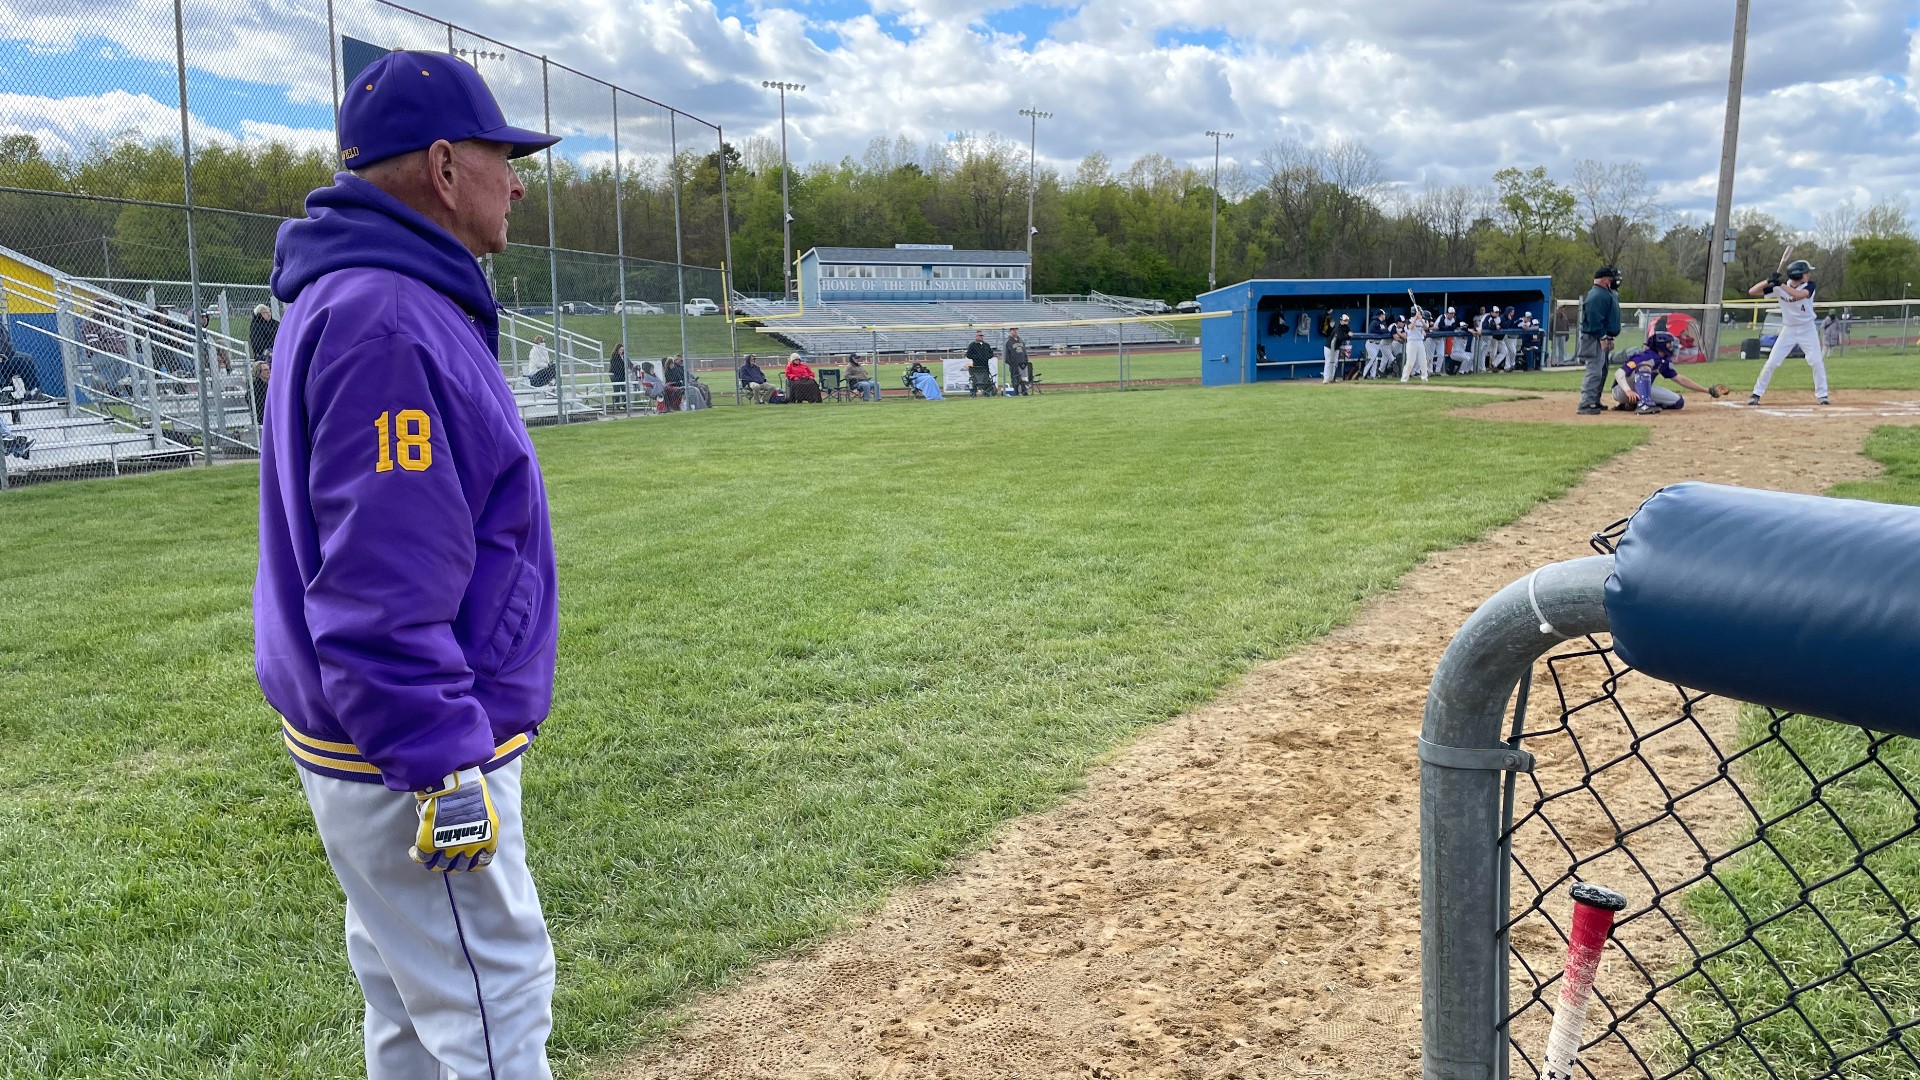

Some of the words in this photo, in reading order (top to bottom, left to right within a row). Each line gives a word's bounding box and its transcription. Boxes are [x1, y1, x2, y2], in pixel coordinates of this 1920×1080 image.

[822, 279, 857, 291] HOME
[861, 279, 877, 291] OF
[882, 280, 905, 291] THE
[910, 280, 969, 291] HILLSDALE
[974, 280, 1023, 291] HORNETS
[1799, 304, 1806, 312] 4
[374, 409, 433, 473] 18
[435, 820, 489, 843] franklin
